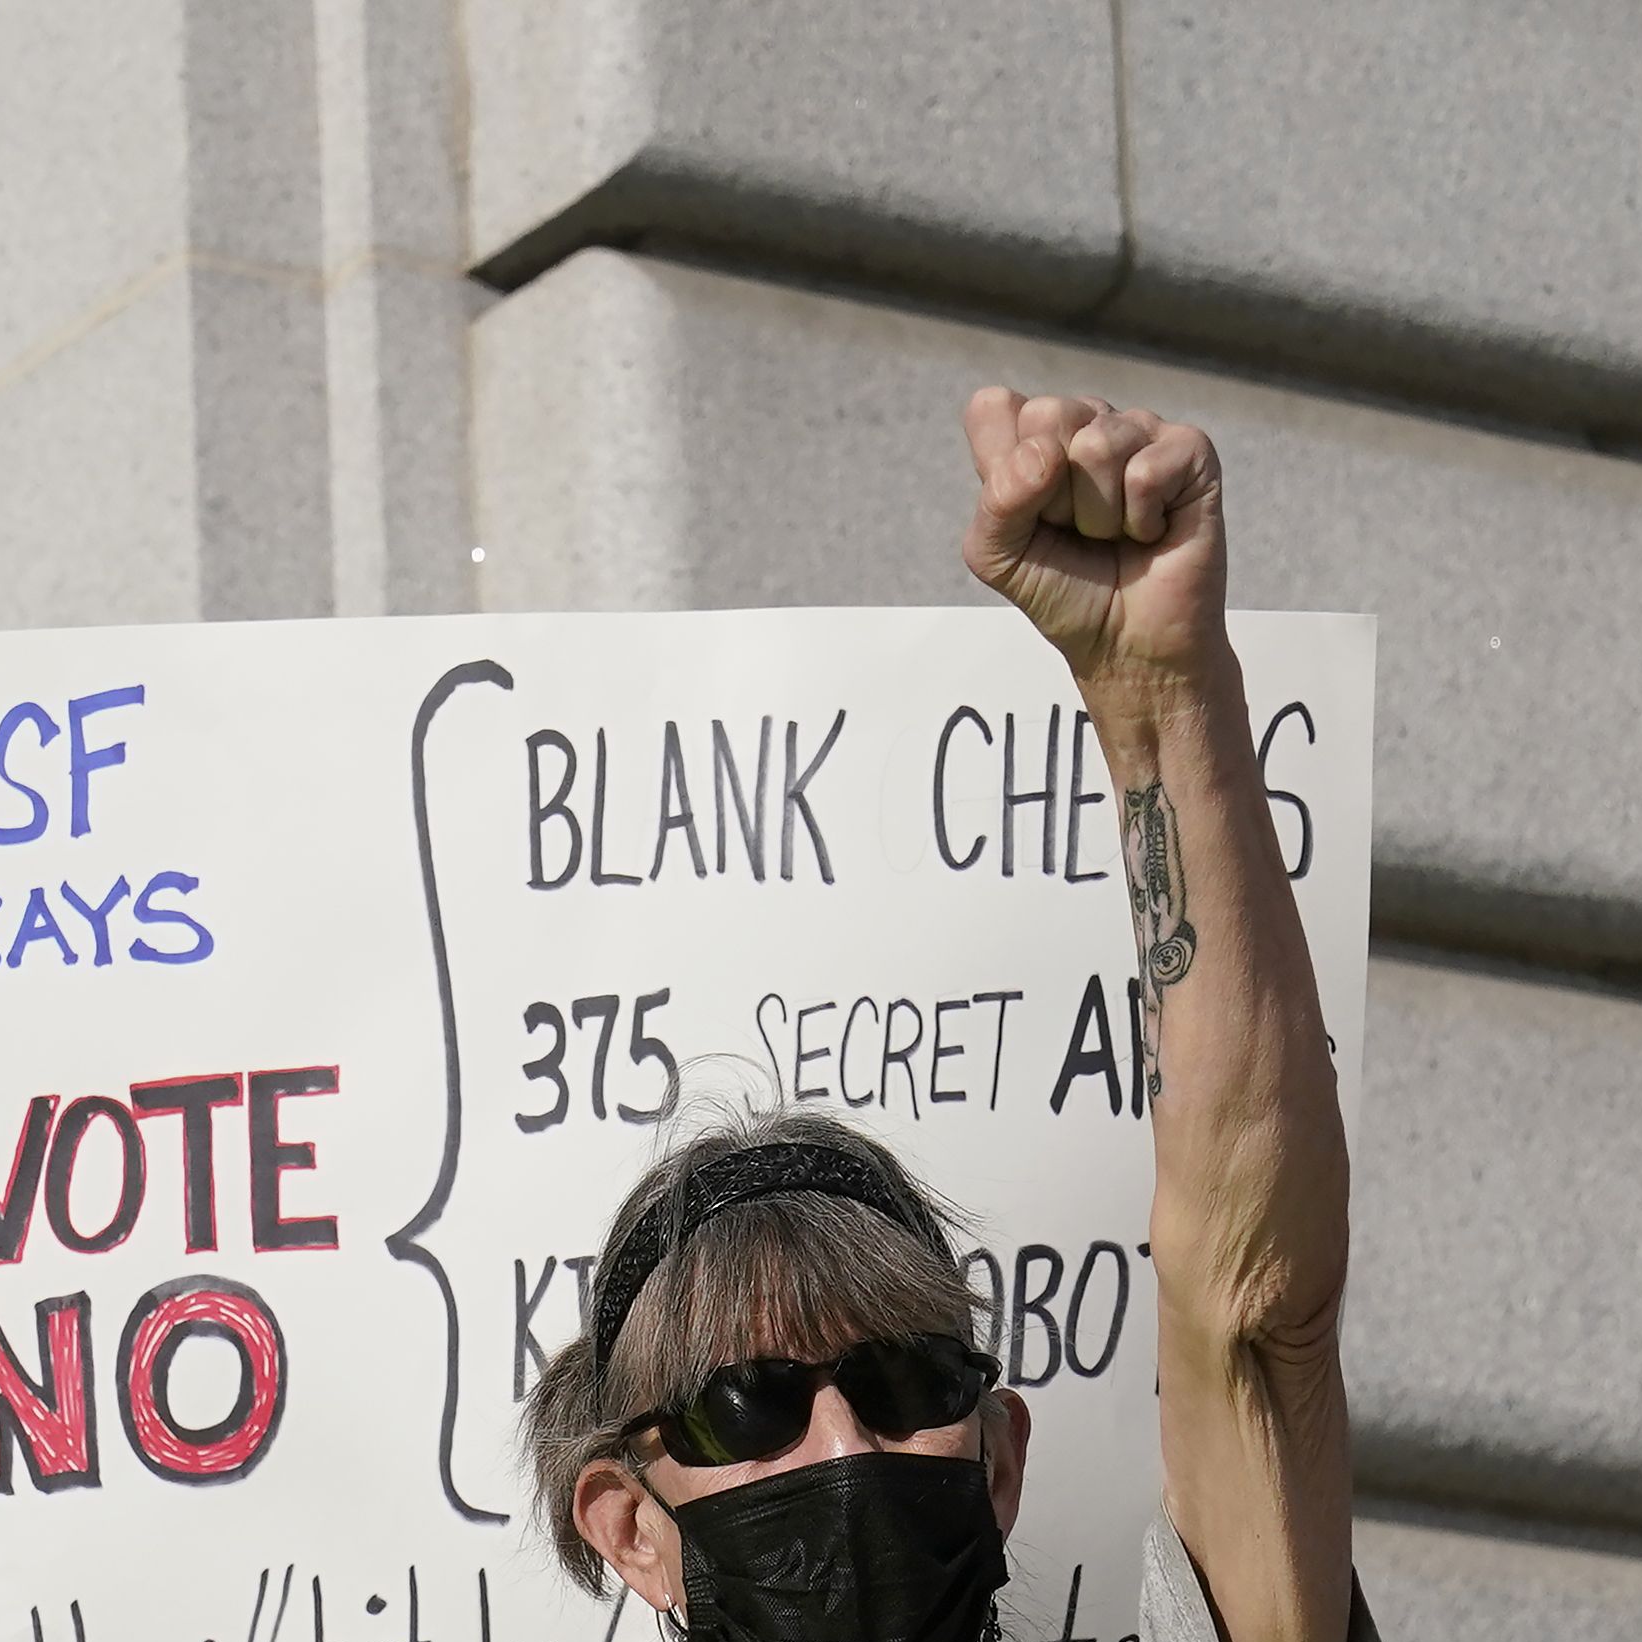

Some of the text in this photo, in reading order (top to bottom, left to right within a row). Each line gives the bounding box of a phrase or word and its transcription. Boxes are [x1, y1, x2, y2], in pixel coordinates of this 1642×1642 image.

[524, 700, 1316, 891] BLANK CHES
[514, 987, 680, 1134] 375
[756, 989, 1023, 1121] SECRET
